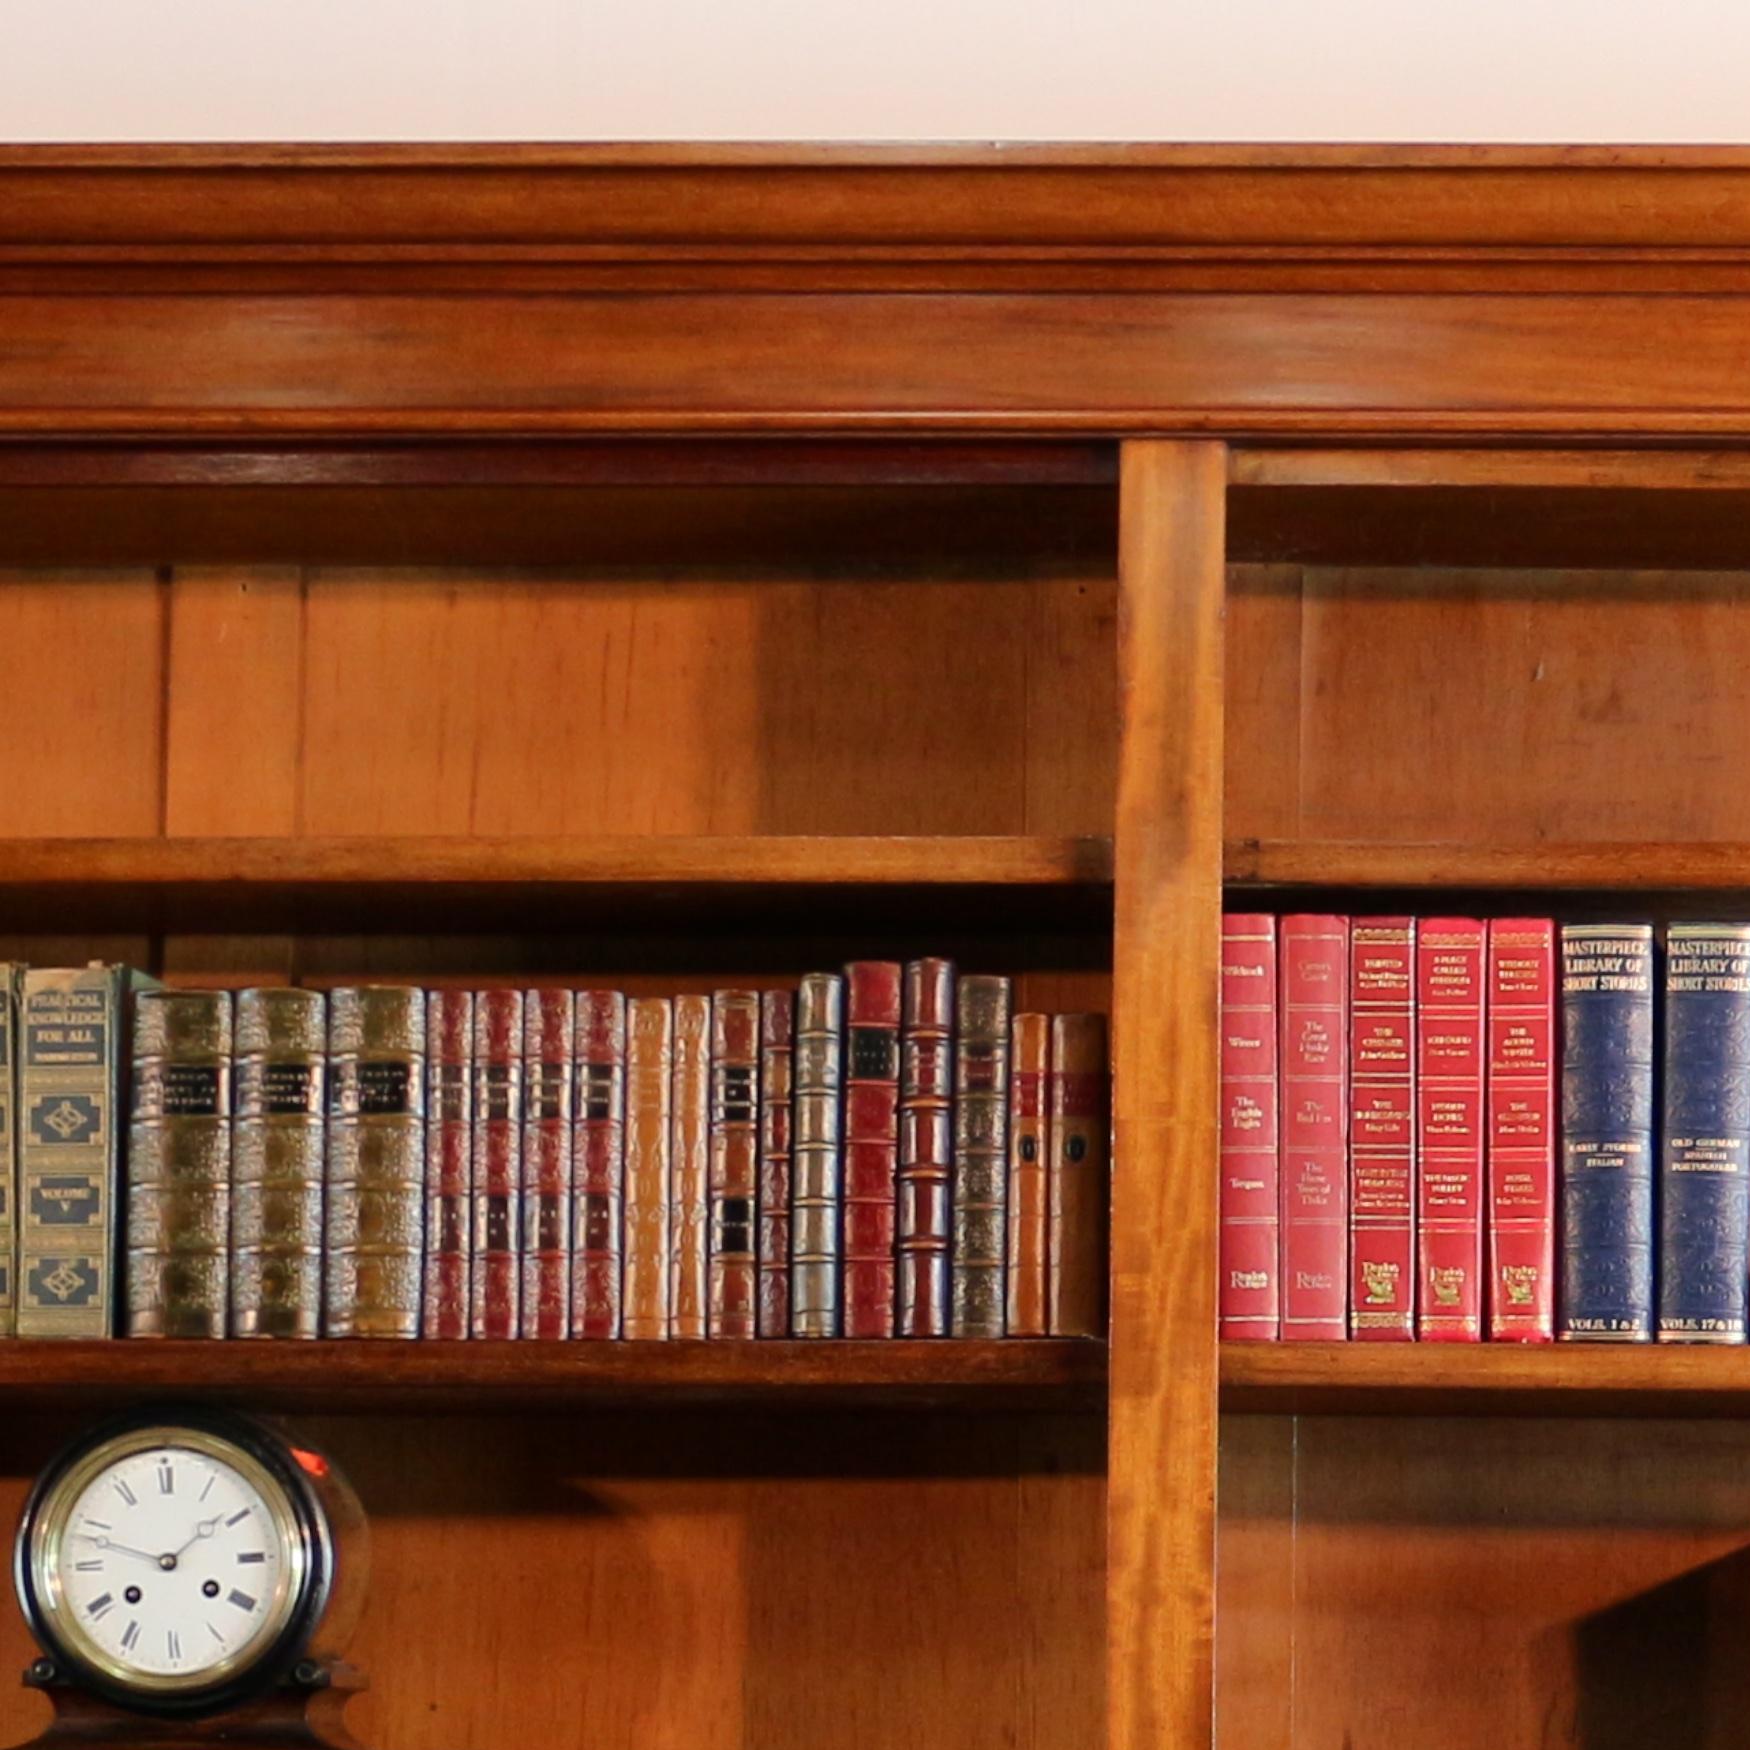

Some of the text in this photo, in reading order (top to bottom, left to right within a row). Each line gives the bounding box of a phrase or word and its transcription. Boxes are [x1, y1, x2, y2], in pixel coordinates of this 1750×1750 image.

[1563, 939, 1648, 956] MASTERPIECE
[1566, 957, 1645, 973] LIBRARY OF
[1670, 957, 1750, 974] LIBRARY OF
[1563, 975, 1648, 991] SHORT STORIES
[1667, 975, 1703, 991] SHORT
[36, 1030, 97, 1043] FOR ALL
[1671, 1139, 1694, 1148] OLD
[41, 1187, 90, 1199] VOLUME
